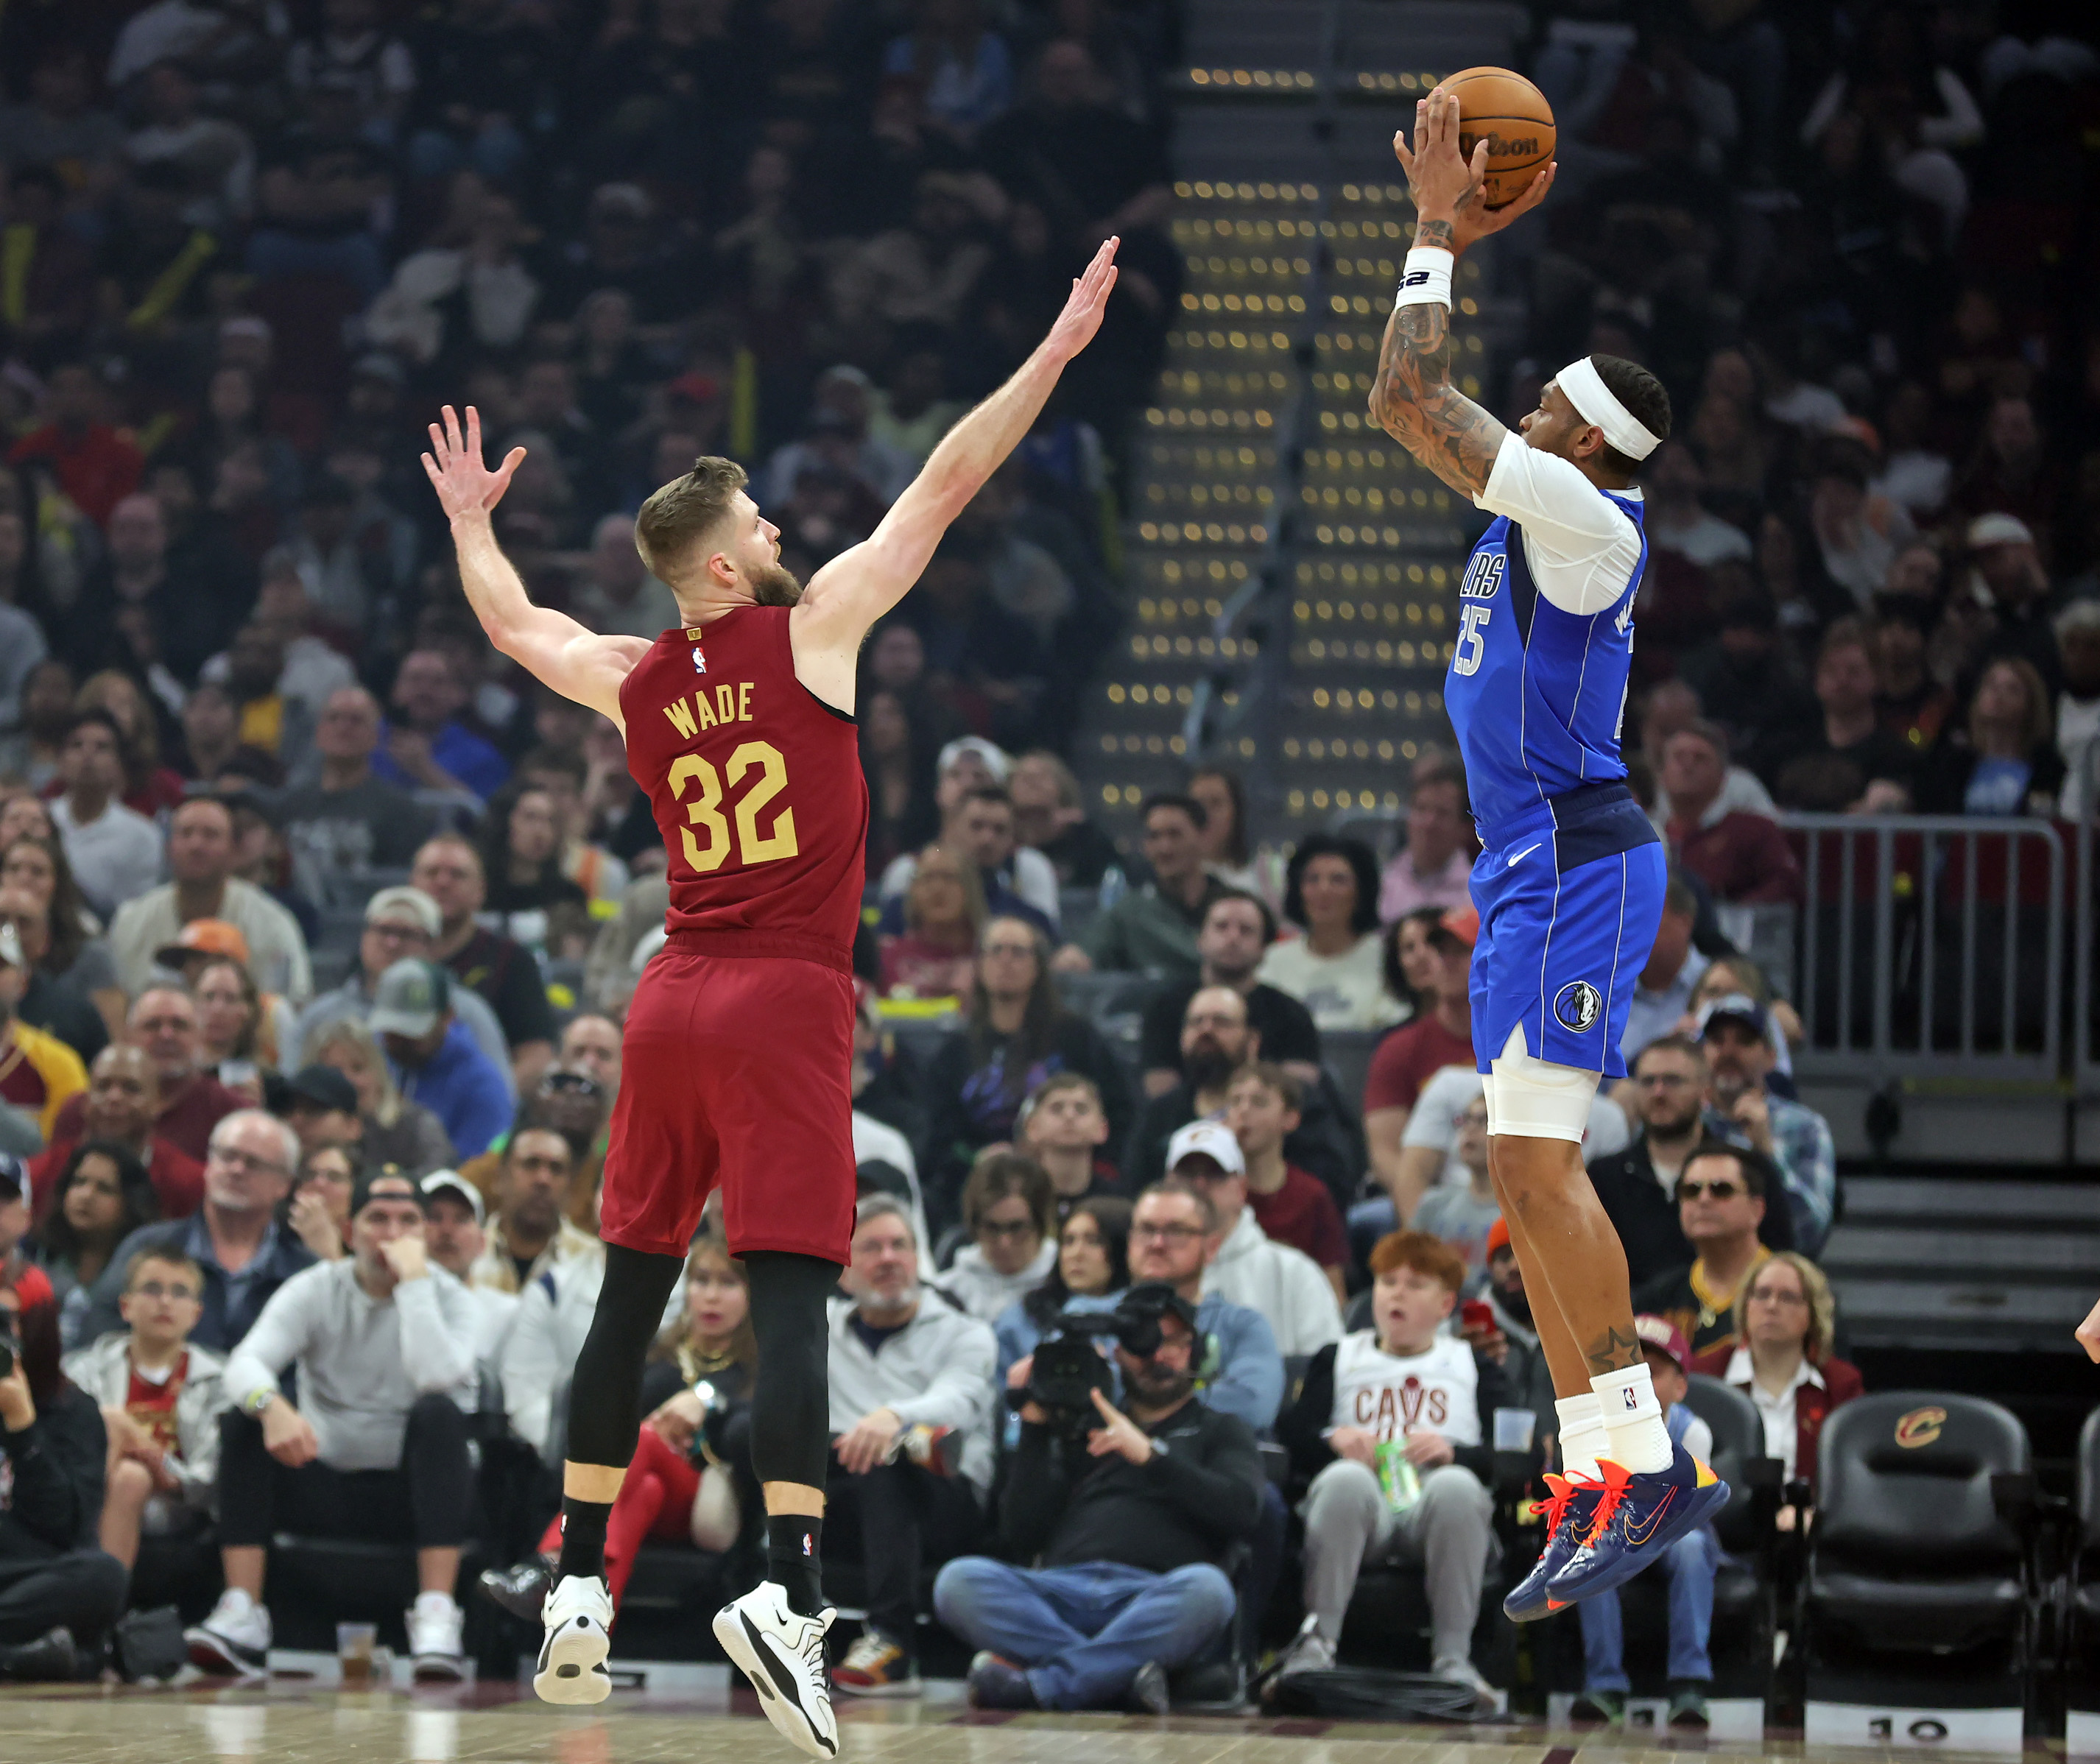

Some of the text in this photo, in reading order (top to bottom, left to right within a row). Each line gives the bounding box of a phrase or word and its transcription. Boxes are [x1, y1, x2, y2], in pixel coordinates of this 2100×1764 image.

[1454, 604, 1492, 677] 25
[662, 682, 755, 740] WADE
[667, 741, 798, 872] 32
[1356, 1387, 1448, 1425] CAVS
